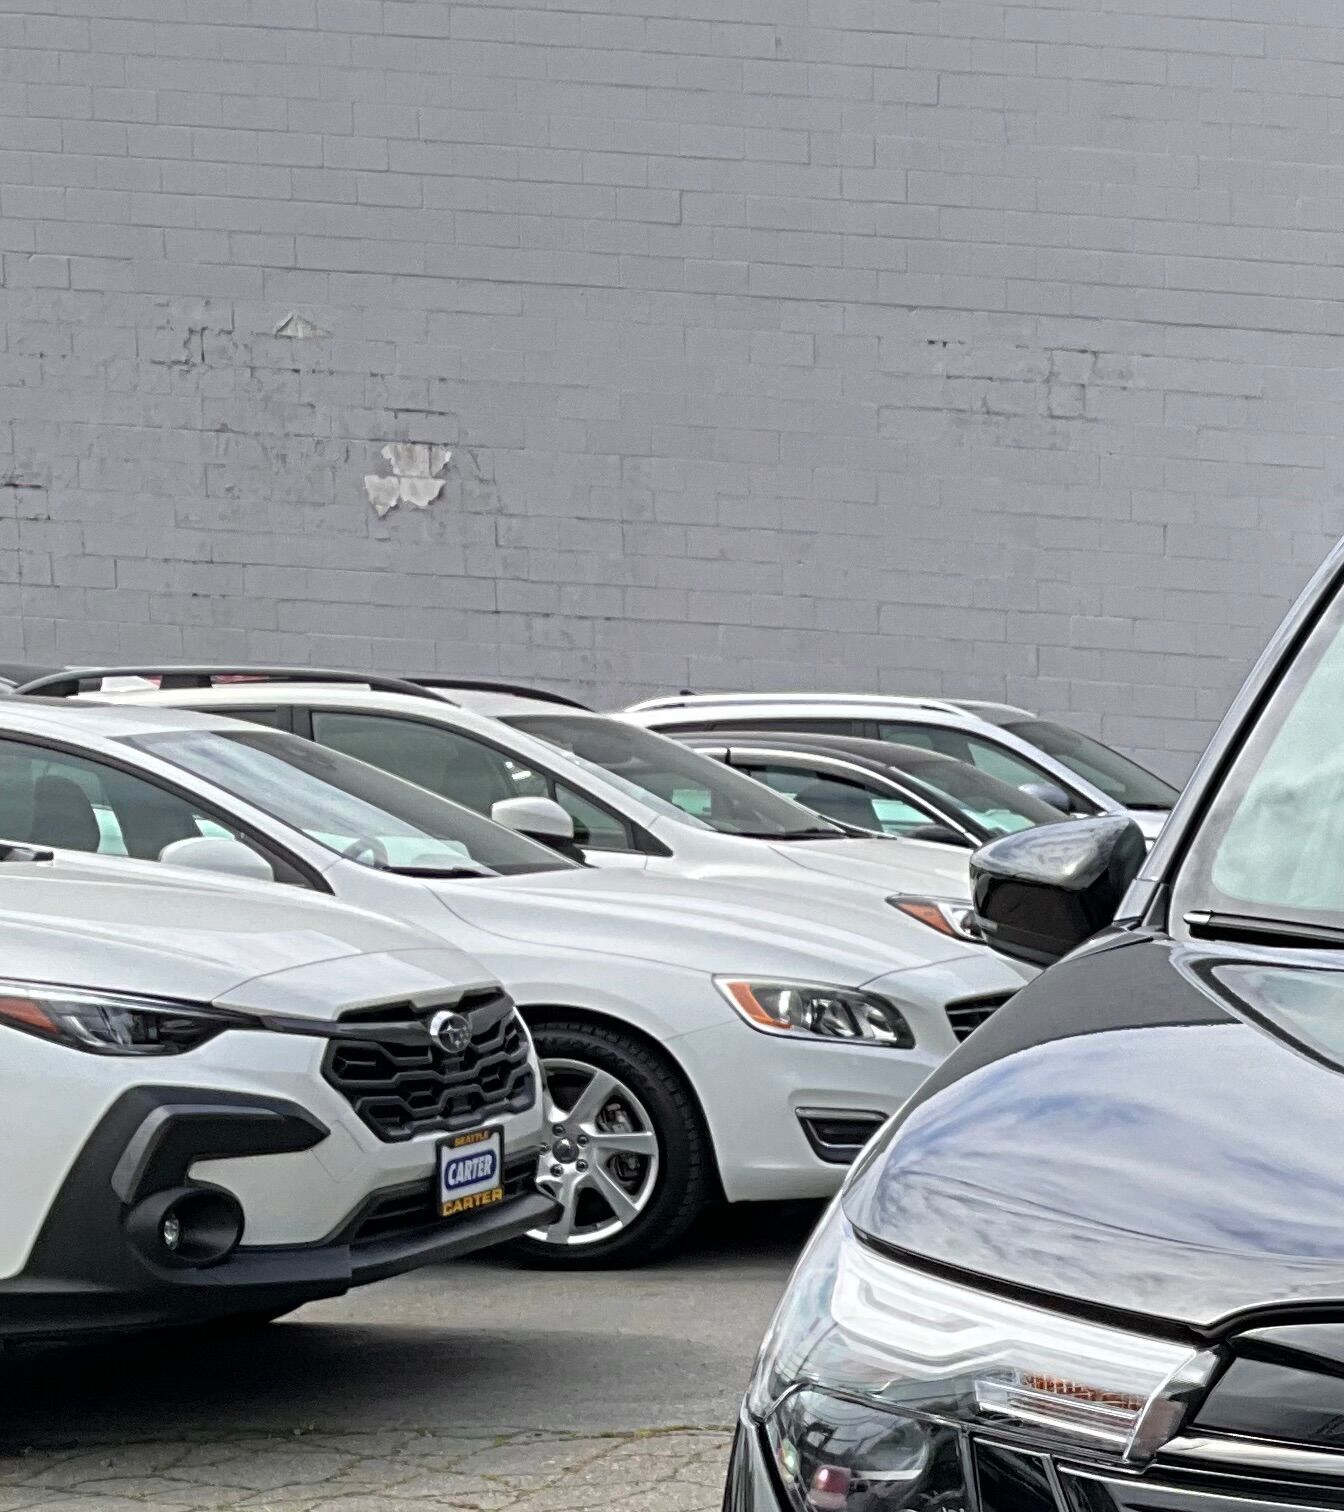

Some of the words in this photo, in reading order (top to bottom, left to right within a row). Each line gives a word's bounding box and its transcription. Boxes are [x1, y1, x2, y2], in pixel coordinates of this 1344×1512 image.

[454, 1131, 489, 1146] SEATTLE
[447, 1154, 493, 1185] CARTER
[442, 1188, 503, 1216] CARTER
